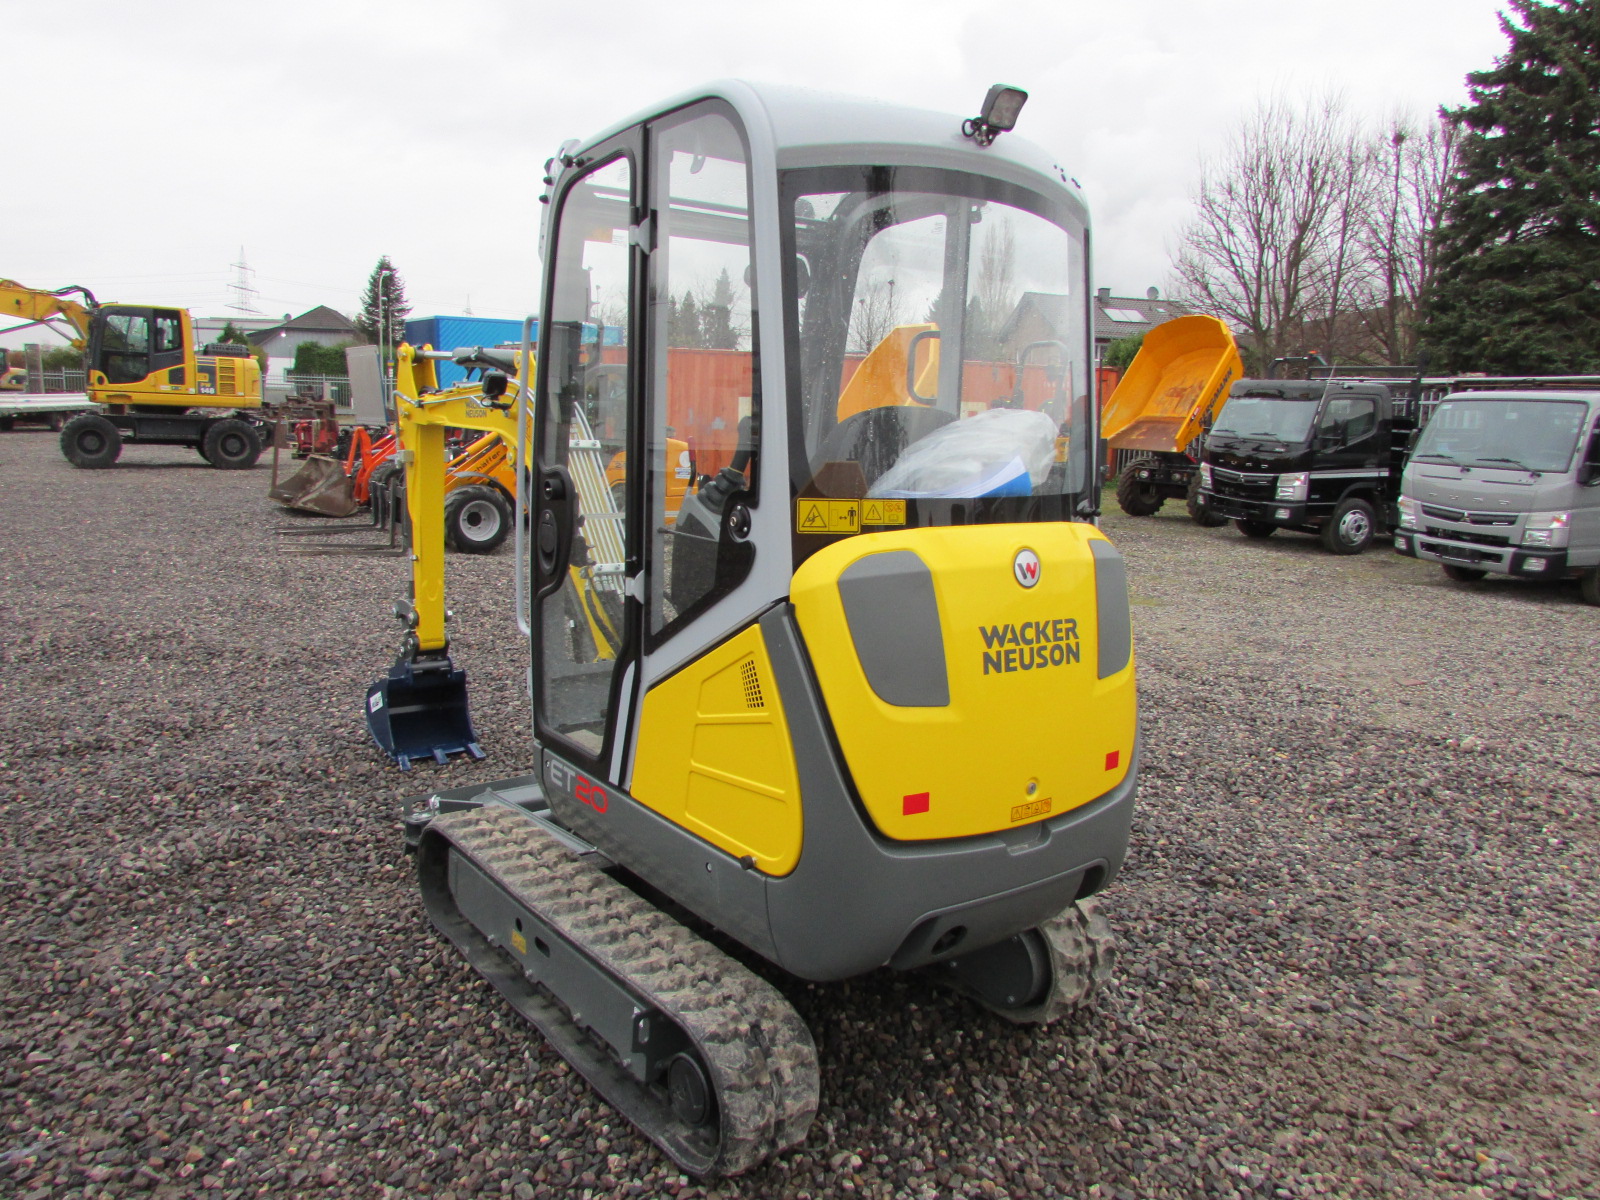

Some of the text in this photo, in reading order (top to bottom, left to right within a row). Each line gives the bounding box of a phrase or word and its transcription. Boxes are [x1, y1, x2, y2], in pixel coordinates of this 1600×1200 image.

[465, 409, 487, 418] NEUSON
[978, 617, 1080, 650] WACKER
[982, 641, 1080, 675] NEUSON
